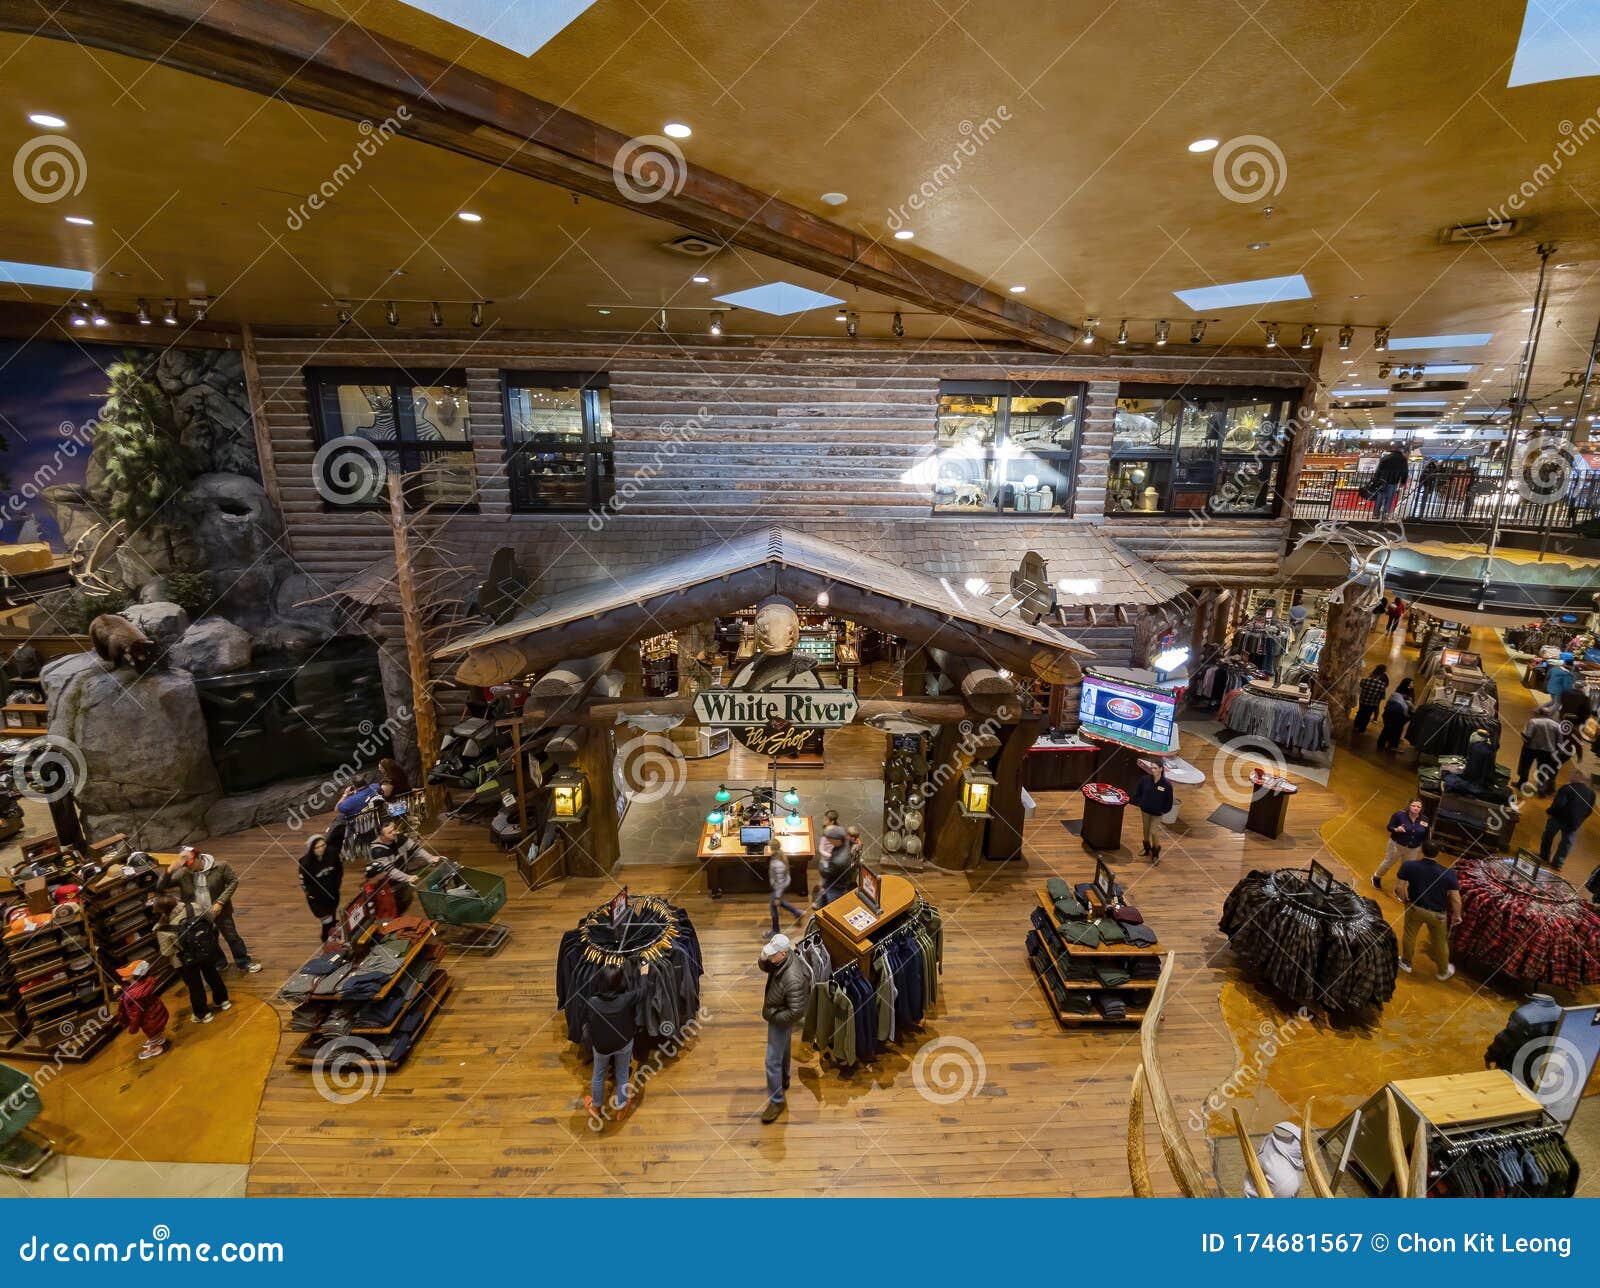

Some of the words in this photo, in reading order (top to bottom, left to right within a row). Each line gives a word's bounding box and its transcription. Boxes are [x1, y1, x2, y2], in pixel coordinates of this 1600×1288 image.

[700, 694, 779, 721] White
[784, 694, 854, 723] River
[744, 726, 769, 753] Fly
[767, 726, 815, 755] Shop
